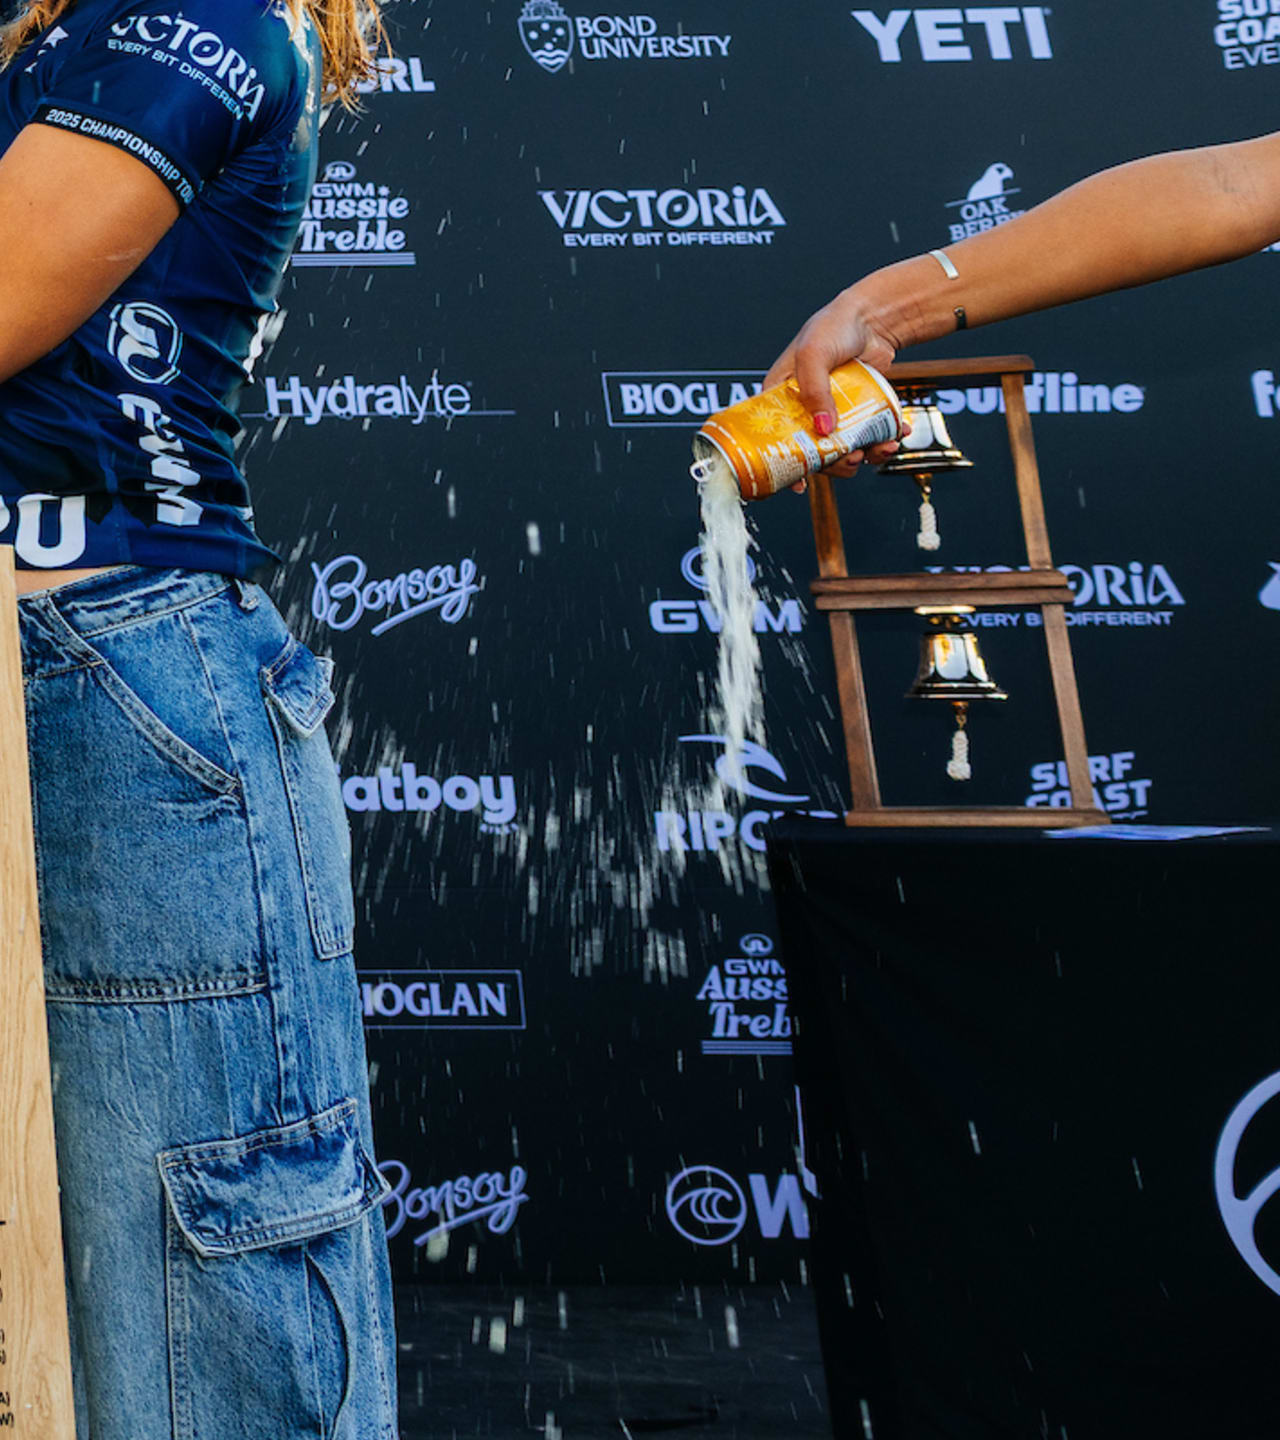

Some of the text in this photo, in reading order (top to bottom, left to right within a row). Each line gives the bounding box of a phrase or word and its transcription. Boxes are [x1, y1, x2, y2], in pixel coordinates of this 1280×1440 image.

[576, 16, 656, 37] BOND
[851, 6, 1053, 62] YETI
[151, 49, 179, 68] BIT
[580, 35, 731, 59] UNIVERSITY
[45, 109, 81, 129] 2025
[80, 116, 181, 183] CHAMPIONSHIP
[312, 183, 375, 198] GWM
[960, 200, 1008, 221] OAK
[563, 231, 775, 247] EVERY BIT DIFFERENT
[264, 376, 472, 425] Hydralyte
[312, 555, 478, 635] Bonsoy
[959, 612, 1021, 628] VERY
[343, 763, 515, 823] atboy
[361, 981, 507, 1017] IOGLAN
